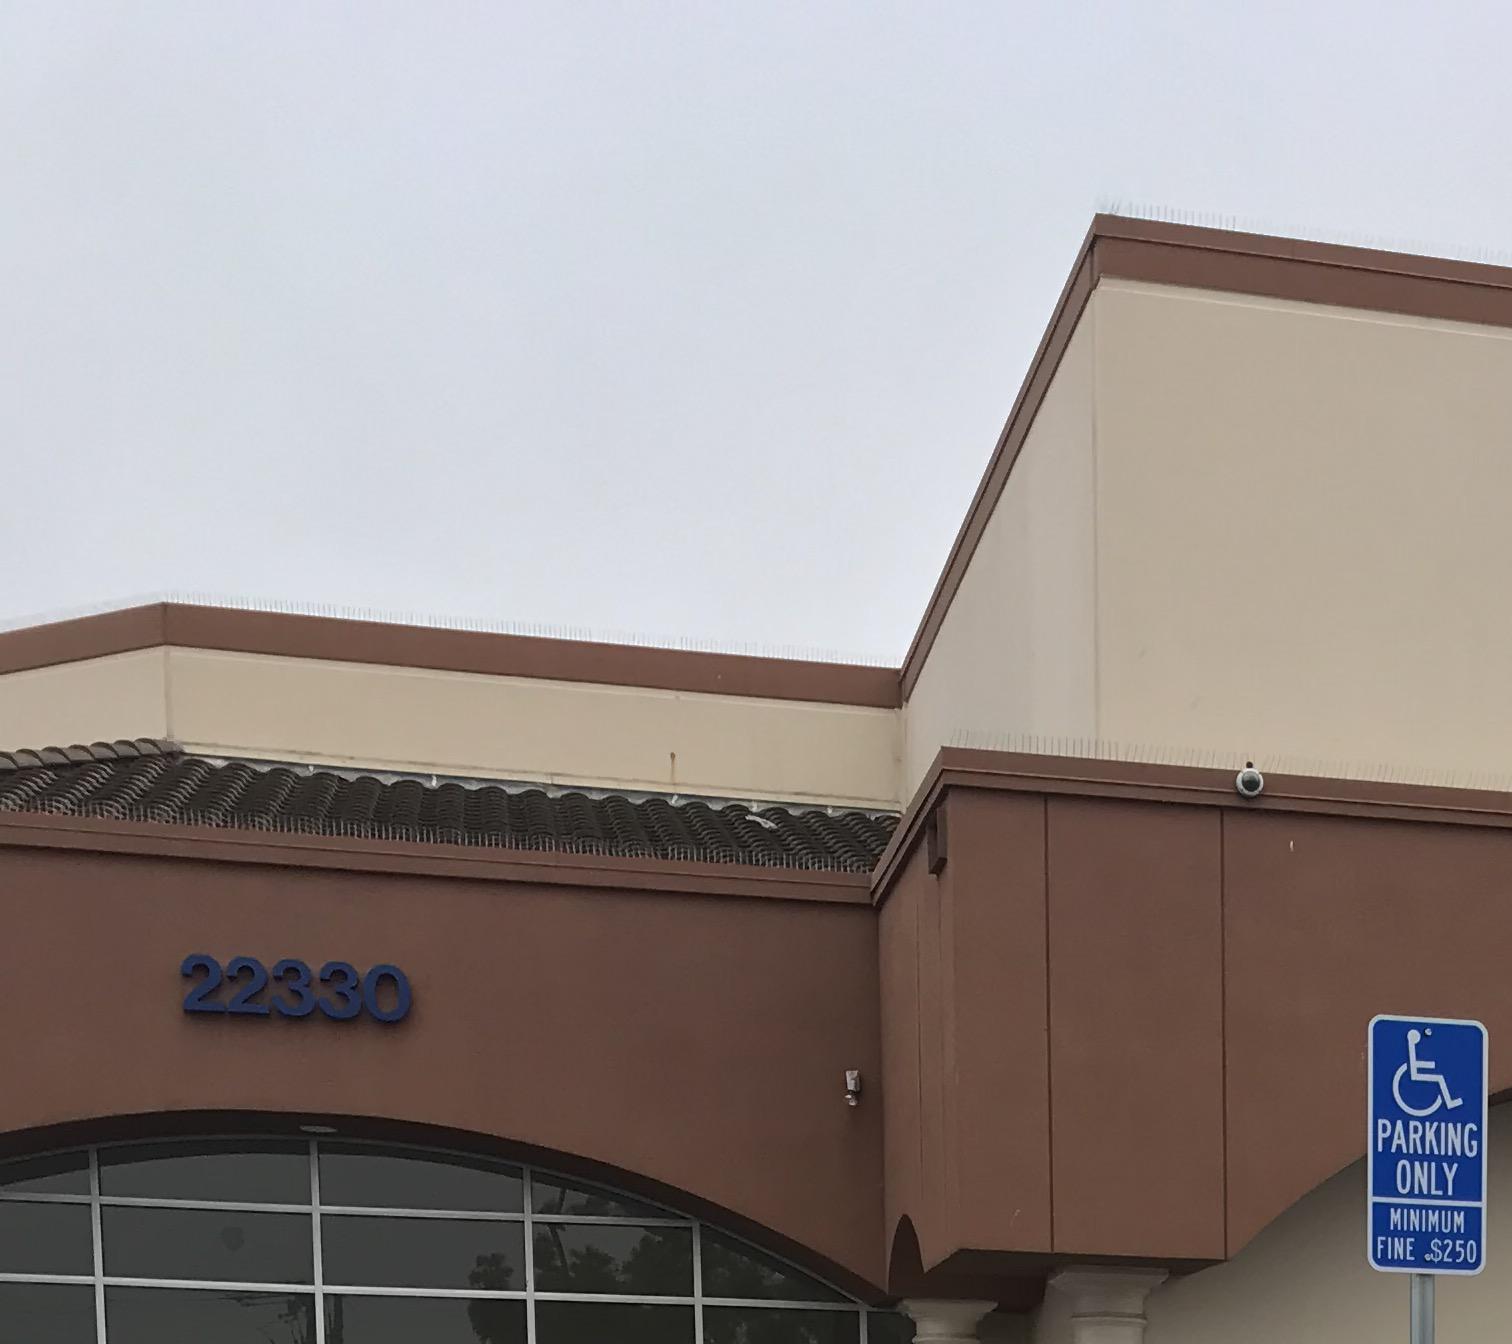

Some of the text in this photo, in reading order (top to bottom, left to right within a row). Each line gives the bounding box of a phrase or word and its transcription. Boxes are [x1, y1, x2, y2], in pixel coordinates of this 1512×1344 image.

[181, 953, 412, 1023] 22330
[1377, 1118, 1478, 1158] PARKING
[1396, 1159, 1458, 1196] ONLY
[1390, 1207, 1465, 1234] MINIMUM
[1377, 1236, 1477, 1263] FINE $250
